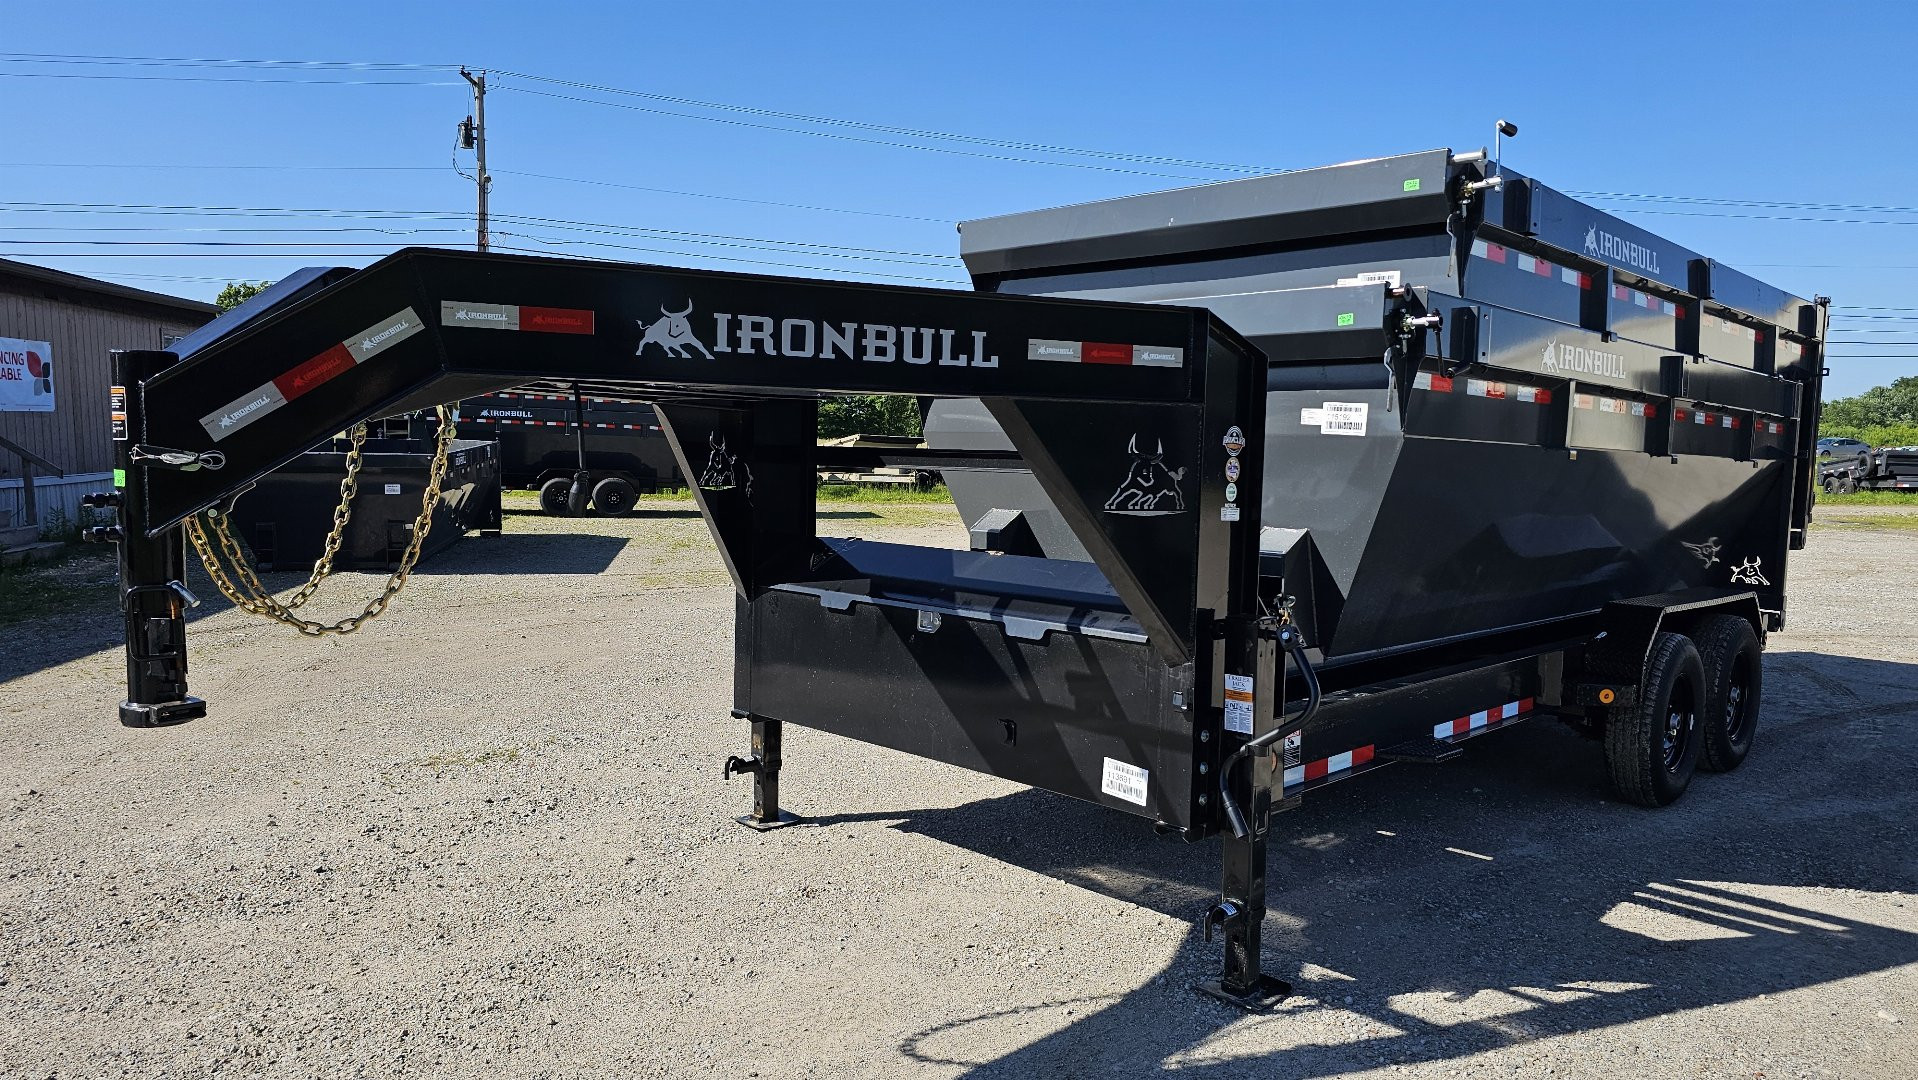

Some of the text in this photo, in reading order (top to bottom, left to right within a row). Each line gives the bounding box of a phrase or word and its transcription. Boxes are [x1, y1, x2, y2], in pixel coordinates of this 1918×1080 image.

[1600, 230, 1660, 275] IRONBULL
[467, 310, 508, 321] IRONBULL
[371, 319, 410, 344] IRONBULL
[713, 312, 999, 368] IRONBULL
[0, 367, 23, 381] ABLE
[1559, 343, 1626, 379] IRONBULL
[229, 394, 271, 421] IRONBULL
[490, 409, 533, 418] IRONBULL
